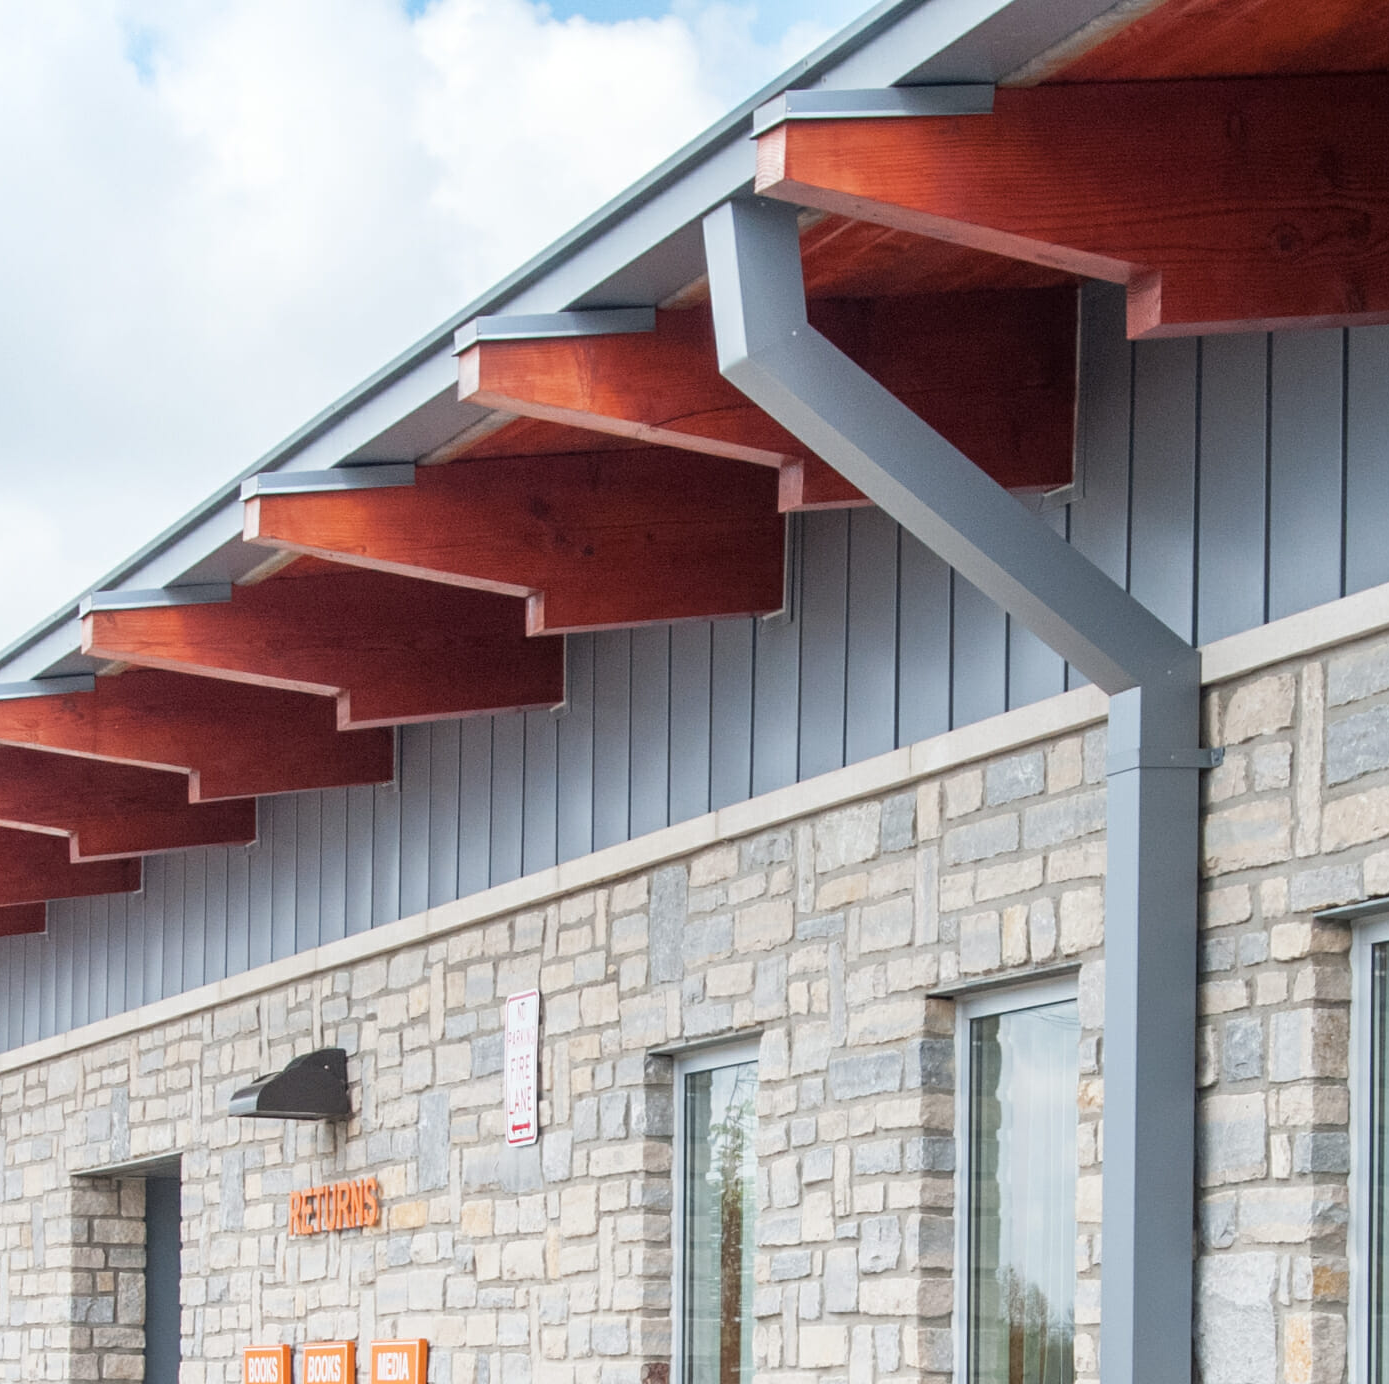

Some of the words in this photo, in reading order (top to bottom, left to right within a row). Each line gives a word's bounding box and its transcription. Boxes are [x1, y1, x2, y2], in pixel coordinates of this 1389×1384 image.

[511, 1054, 531, 1081] FIRE
[509, 1086, 532, 1114] LANE
[288, 1176, 378, 1237] RETURNS
[248, 1357, 278, 1383] BOOKS
[307, 1354, 341, 1383] BOOKS
[377, 1352, 410, 1381] MEDIA
